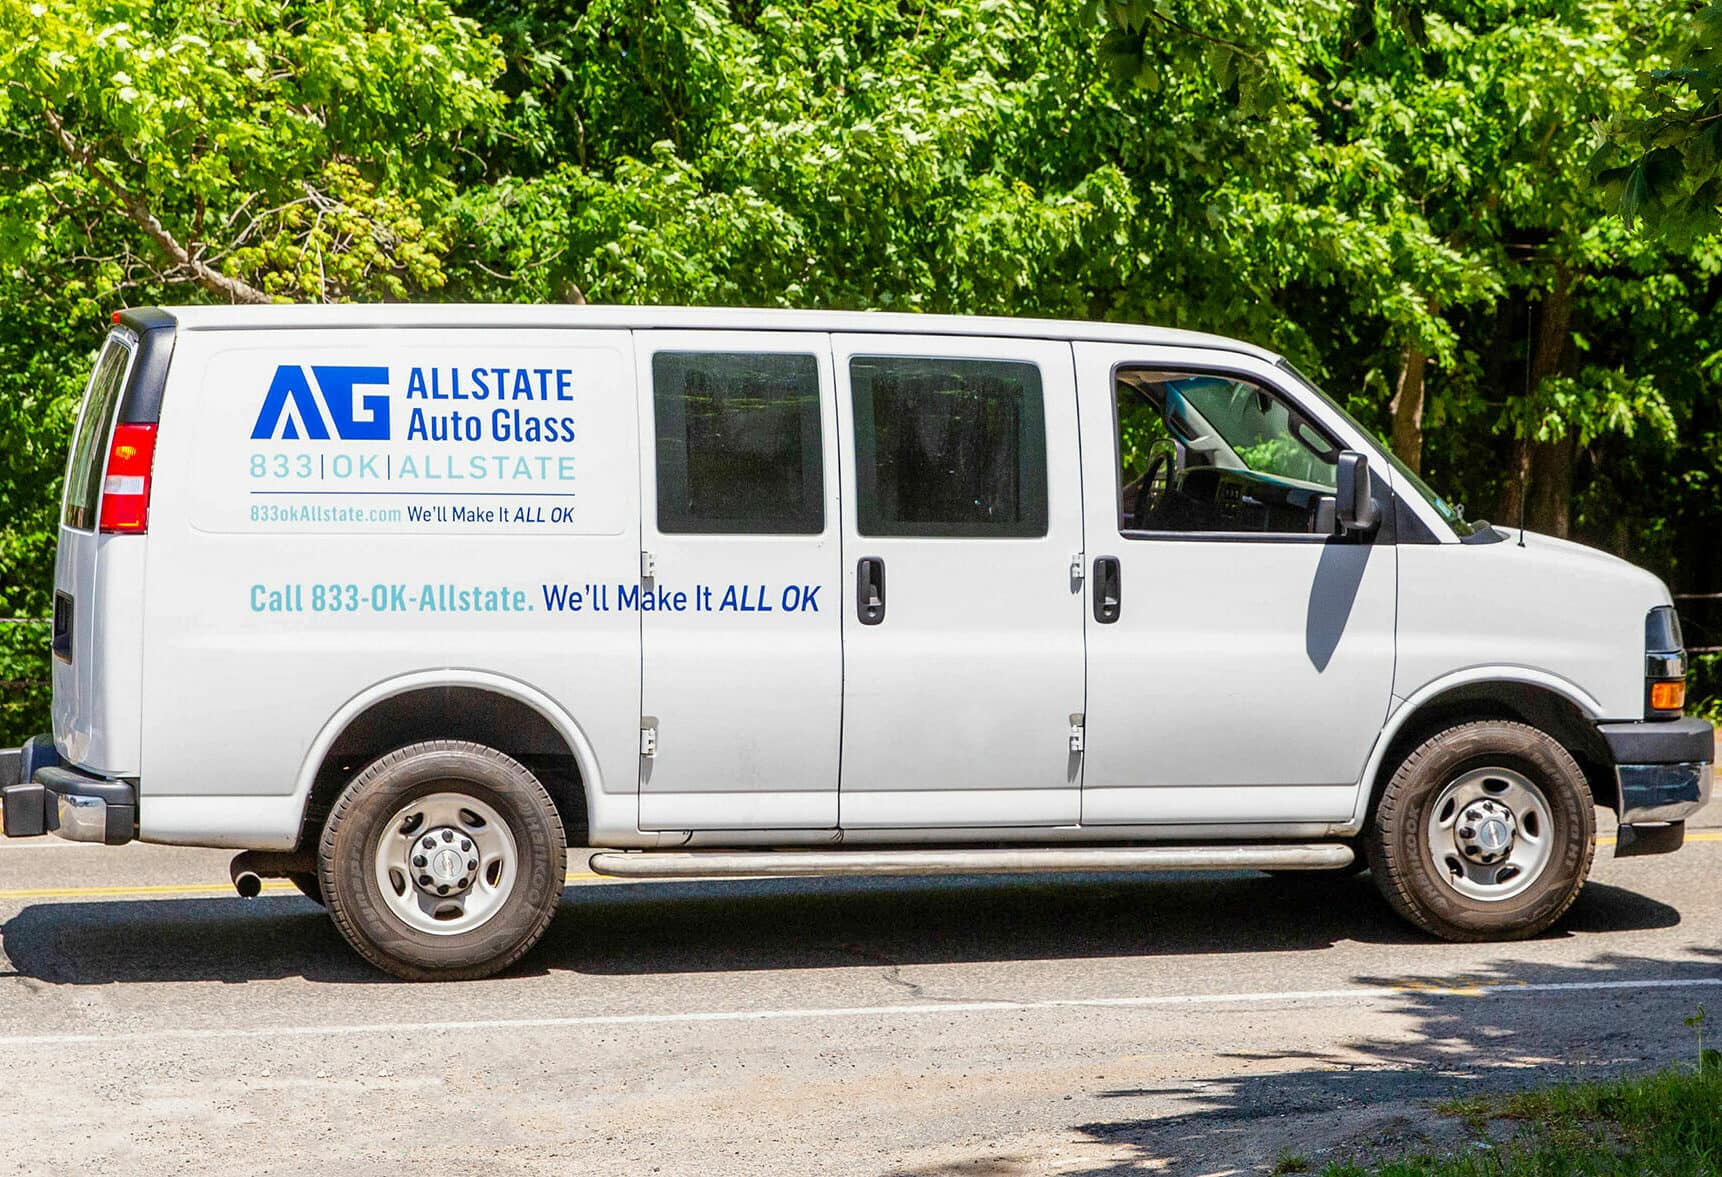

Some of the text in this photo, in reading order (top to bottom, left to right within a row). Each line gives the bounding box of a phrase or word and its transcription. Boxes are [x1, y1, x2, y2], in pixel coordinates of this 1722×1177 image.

[406, 367, 574, 402] ALLSTATE
[250, 365, 392, 440] AG
[406, 407, 576, 443] Auto Glass
[398, 455, 576, 481] ALLSTATE
[250, 505, 575, 524] 833okAllstate.com We'll Make It ALL OK
[249, 583, 822, 613] Call 833-OK-Allstate. We'll Make It ALL OK
